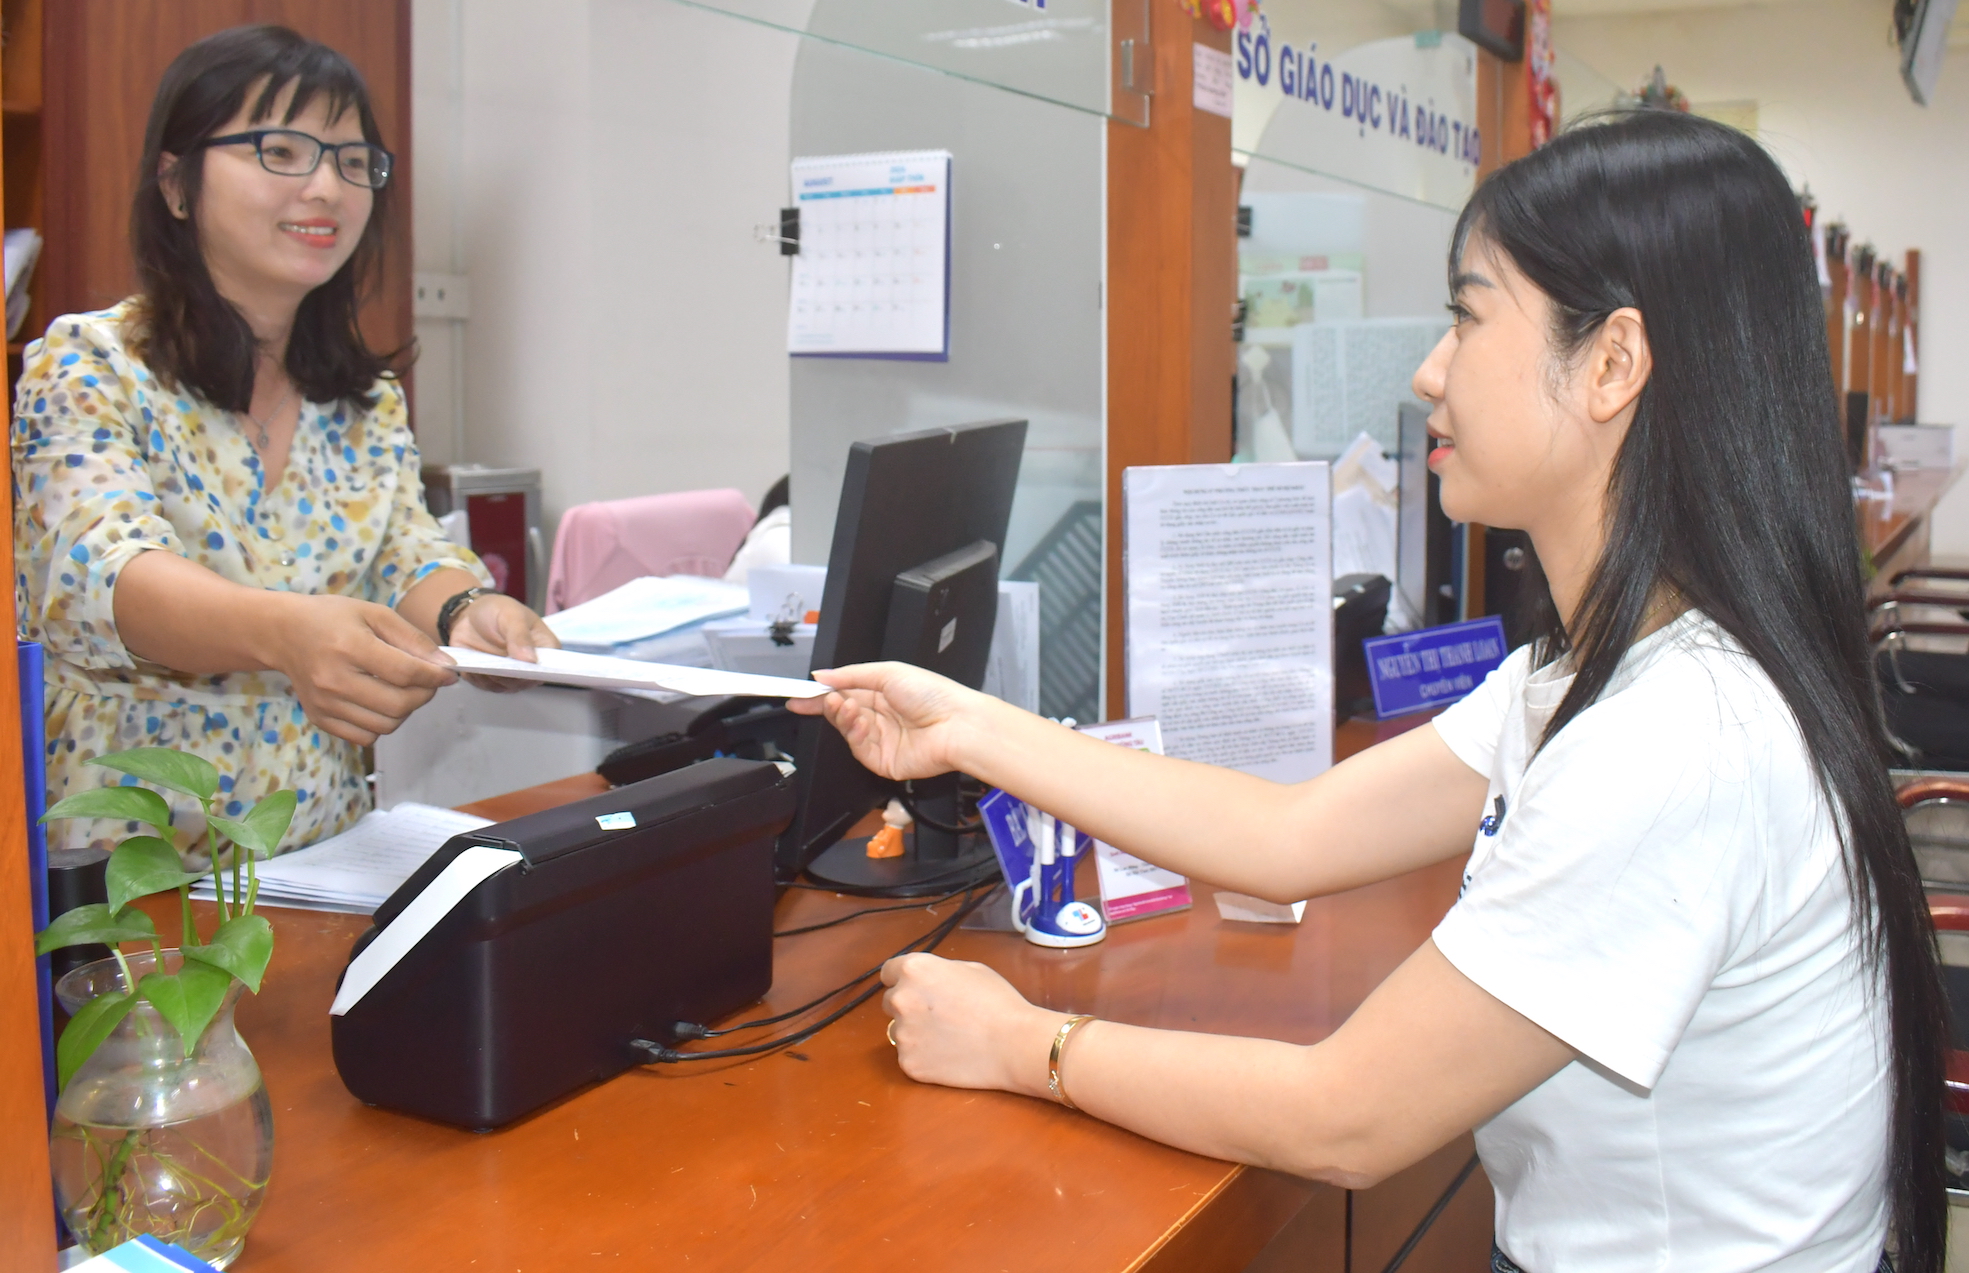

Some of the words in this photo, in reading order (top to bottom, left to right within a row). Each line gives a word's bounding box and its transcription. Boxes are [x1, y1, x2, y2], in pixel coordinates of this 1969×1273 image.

[1280, 43, 1334, 110] GIÁO
[1342, 72, 1381, 138] DỤC
[1387, 84, 1410, 141] VÀ
[1416, 97, 1448, 154] ĐÀO
[1452, 120, 1482, 176] TẠO
